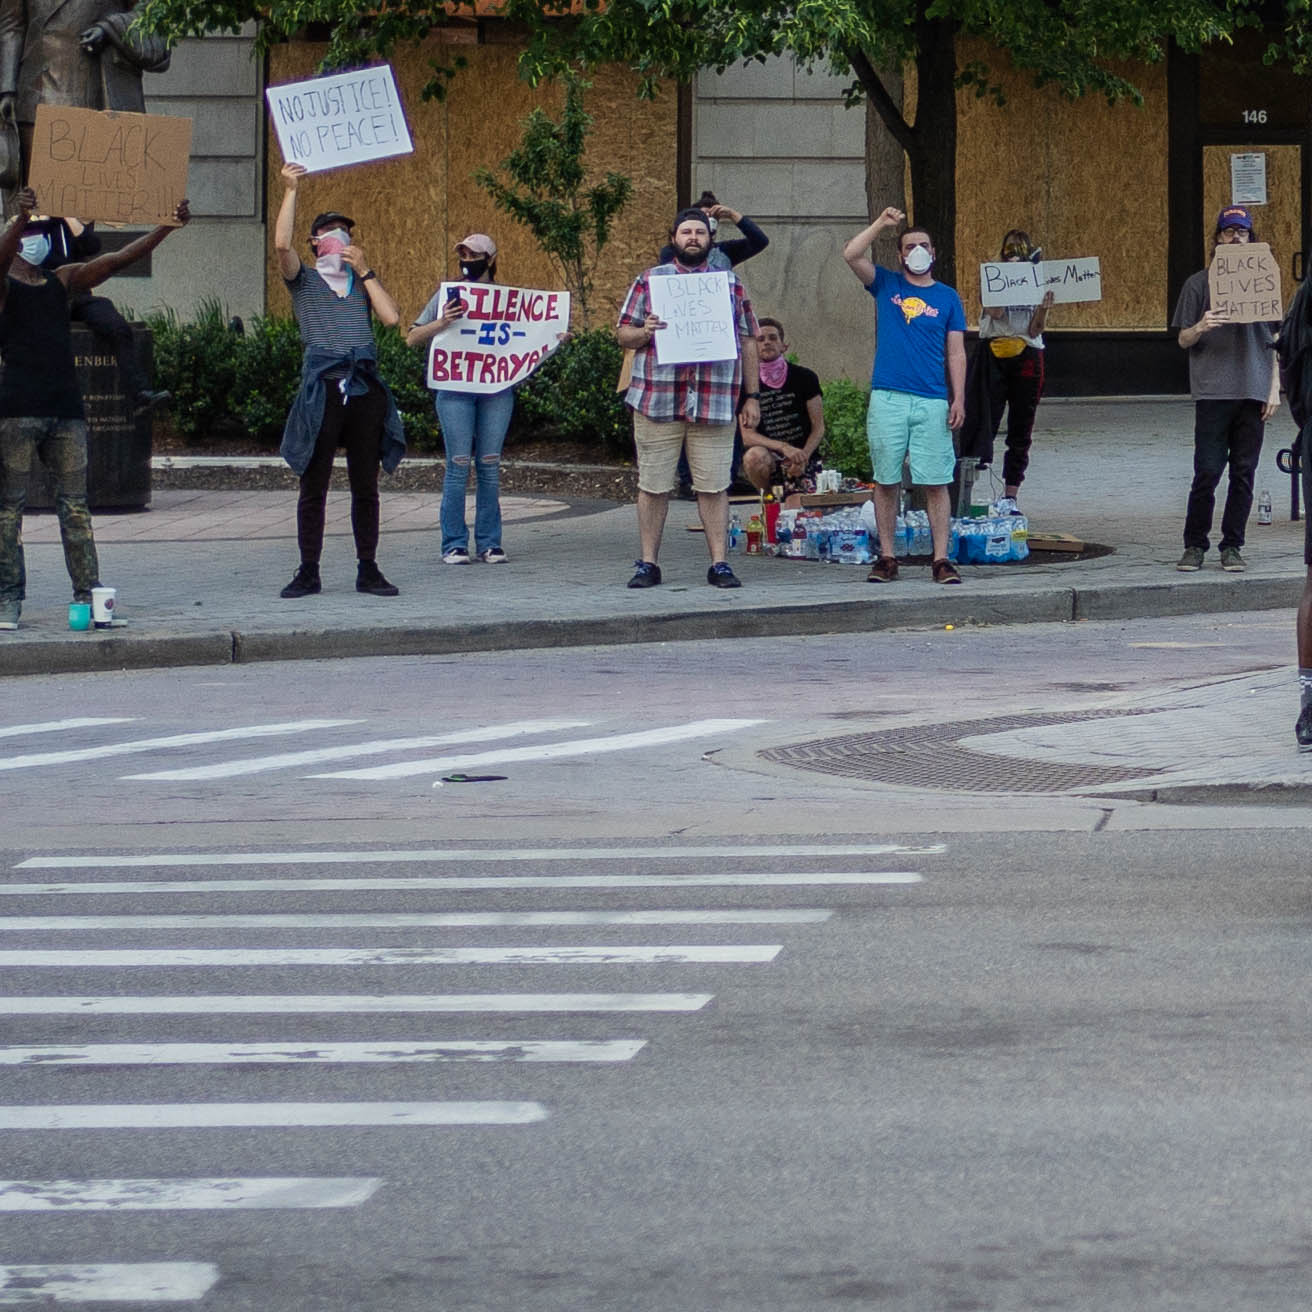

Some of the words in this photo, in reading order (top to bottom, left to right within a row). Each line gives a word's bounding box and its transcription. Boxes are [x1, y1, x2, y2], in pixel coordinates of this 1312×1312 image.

[278, 95, 305, 125] NO
[304, 77, 392, 117] JUSTICE!
[1242, 110, 1267, 124] 146
[49, 119, 167, 170] BLACK
[290, 130, 312, 159] NO
[317, 114, 399, 152] PEACE!
[81, 165, 138, 190] LIVES
[1216, 256, 1268, 277] BLACK
[1216, 274, 1276, 296] LIVES
[1215, 299, 1280, 317] MATTER
[432, 344, 549, 384] BETRAYA
